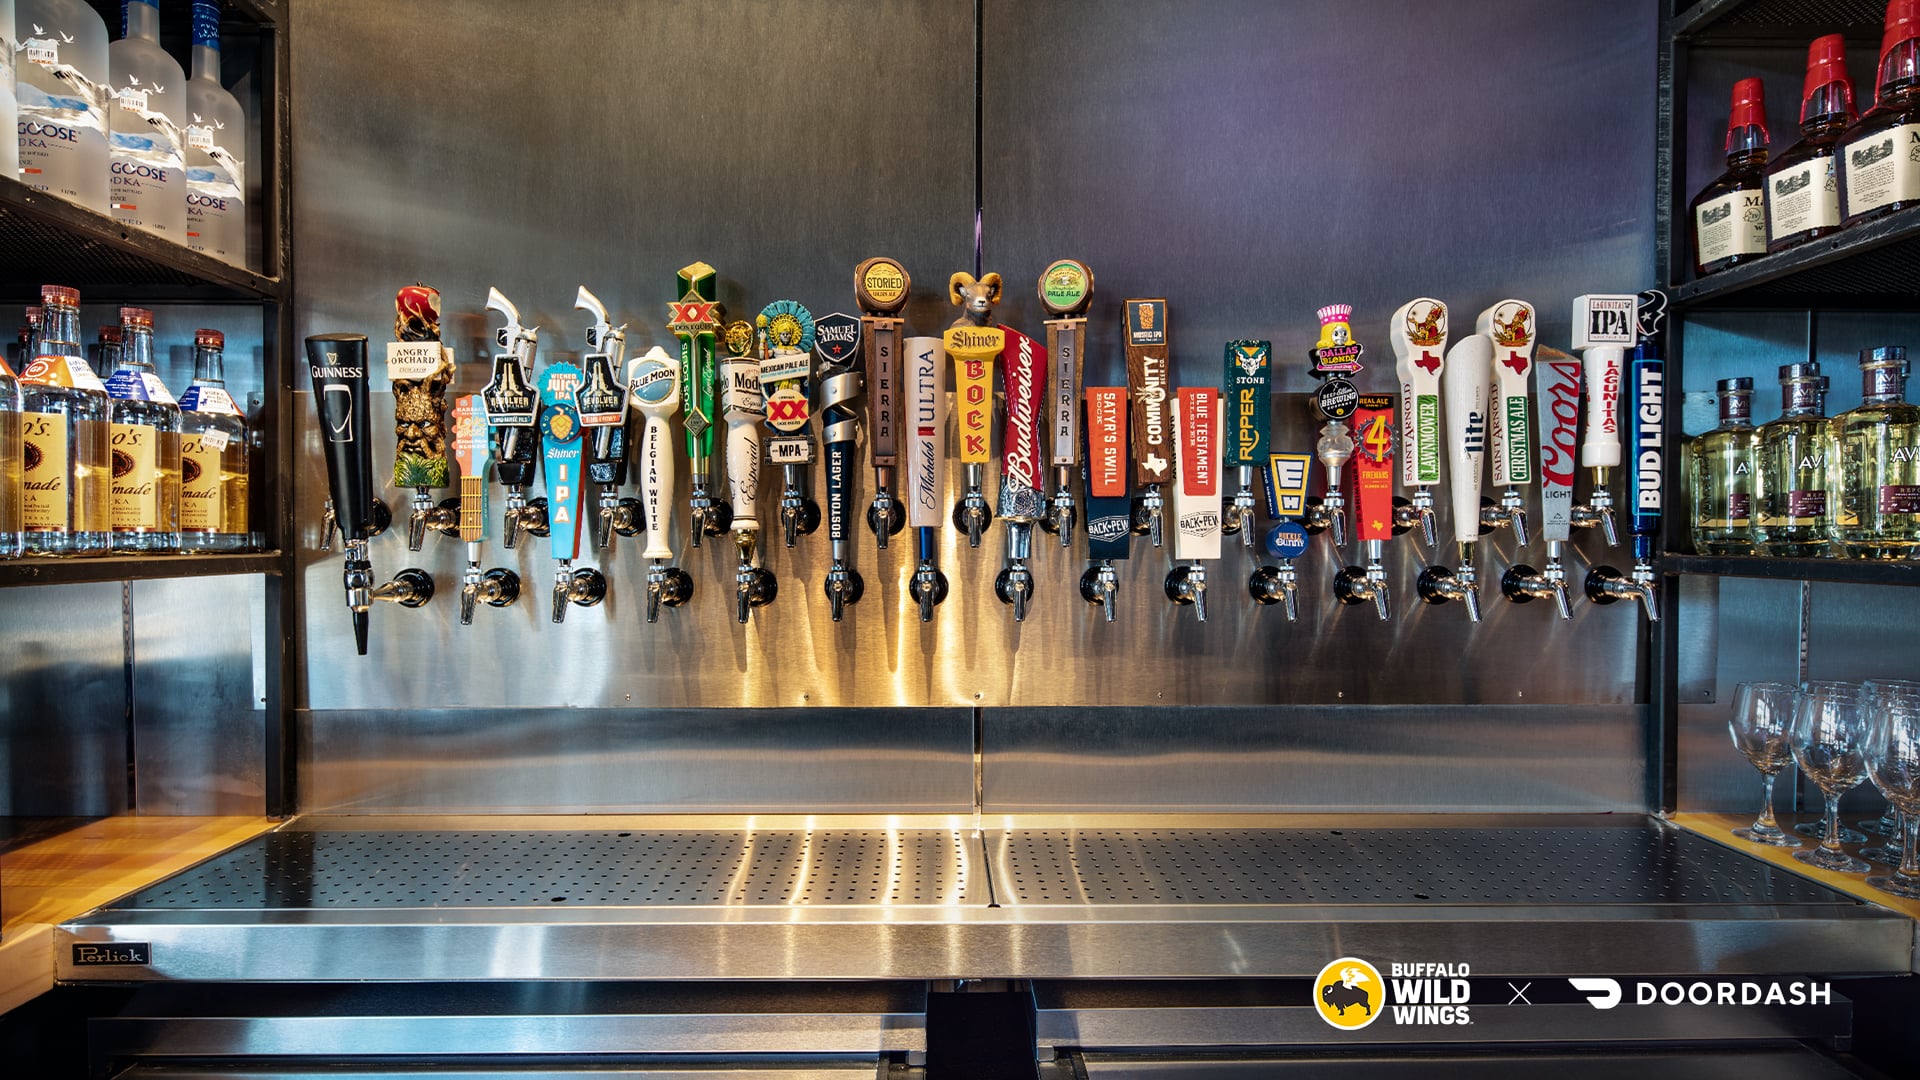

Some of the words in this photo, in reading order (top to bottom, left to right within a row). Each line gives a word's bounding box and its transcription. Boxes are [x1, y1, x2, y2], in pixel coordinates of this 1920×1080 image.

[111, 162, 167, 182] GOOSE
[187, 194, 227, 210] OOSE
[866, 277, 903, 289] STORIED
[673, 303, 714, 323] XX
[1592, 301, 1625, 309] LAGUNITAS
[817, 323, 857, 335] SAMUEL
[1591, 310, 1629, 335] IPA
[820, 331, 854, 344] ADAMS
[950, 330, 1000, 349] Shiner
[391, 356, 435, 365] ORCHARD
[1320, 346, 1358, 358] DALLAS
[1322, 355, 1355, 365] BLONDE
[311, 365, 363, 378] GUINNESS
[630, 375, 649, 391] BLUE
[649, 367, 675, 382] MOON
[760, 364, 784, 374] MEXICAN
[785, 362, 798, 370] PALE
[799, 359, 808, 367] ALE
[547, 379, 580, 392] JUICY
[735, 372, 761, 391] Mod
[880, 346, 890, 437] SIERRA
[919, 349, 935, 423] ULTRA
[1060, 347, 1071, 436] SIERRA
[1236, 377, 1265, 385] STONE
[555, 391, 572, 400] IPA
[965, 360, 985, 455] BOCK
[1196, 393, 1208, 419] BLUE
[1321, 392, 1357, 408] BREWING
[1509, 398, 1525, 418] ALE
[1602, 360, 1619, 434] LAGUNITAS
[1639, 368, 1662, 447] LIGHT
[767, 400, 809, 420] XX
[1007, 336, 1033, 493] Budweiser
[1103, 393, 1117, 443] SATYR'S
[1404, 383, 1415, 440] ARNOLD
[1491, 383, 1502, 440] ARNOLD
[1239, 387, 1259, 461] RIPPER
[1542, 362, 1580, 488] Coors
[779, 444, 801, 457] MPA
[1367, 415, 1388, 462] 4
[1420, 403, 1436, 474] LAWNMOWER
[1510, 420, 1527, 480] CHRISTMAS
[546, 447, 579, 459] Shiner
[649, 426, 658, 484] BELGIAN
[1197, 423, 1209, 485] TESTAMENT
[1404, 442, 1412, 482] SAINT
[1494, 441, 1502, 481] SAINT
[741, 436, 759, 505] Especial
[832, 451, 842, 489] LAGER
[919, 440, 936, 510] Michelob
[1104, 448, 1117, 486] SWILL
[1639, 450, 1662, 508] BUD
[112, 482, 151, 496] made
[182, 487, 217, 499] made
[554, 463, 571, 524] IPA
[1545, 490, 1571, 499] LIGHT
[649, 489, 658, 531] WHITE
[831, 493, 842, 538] BOSTON
[77, 947, 143, 963] Perlick
